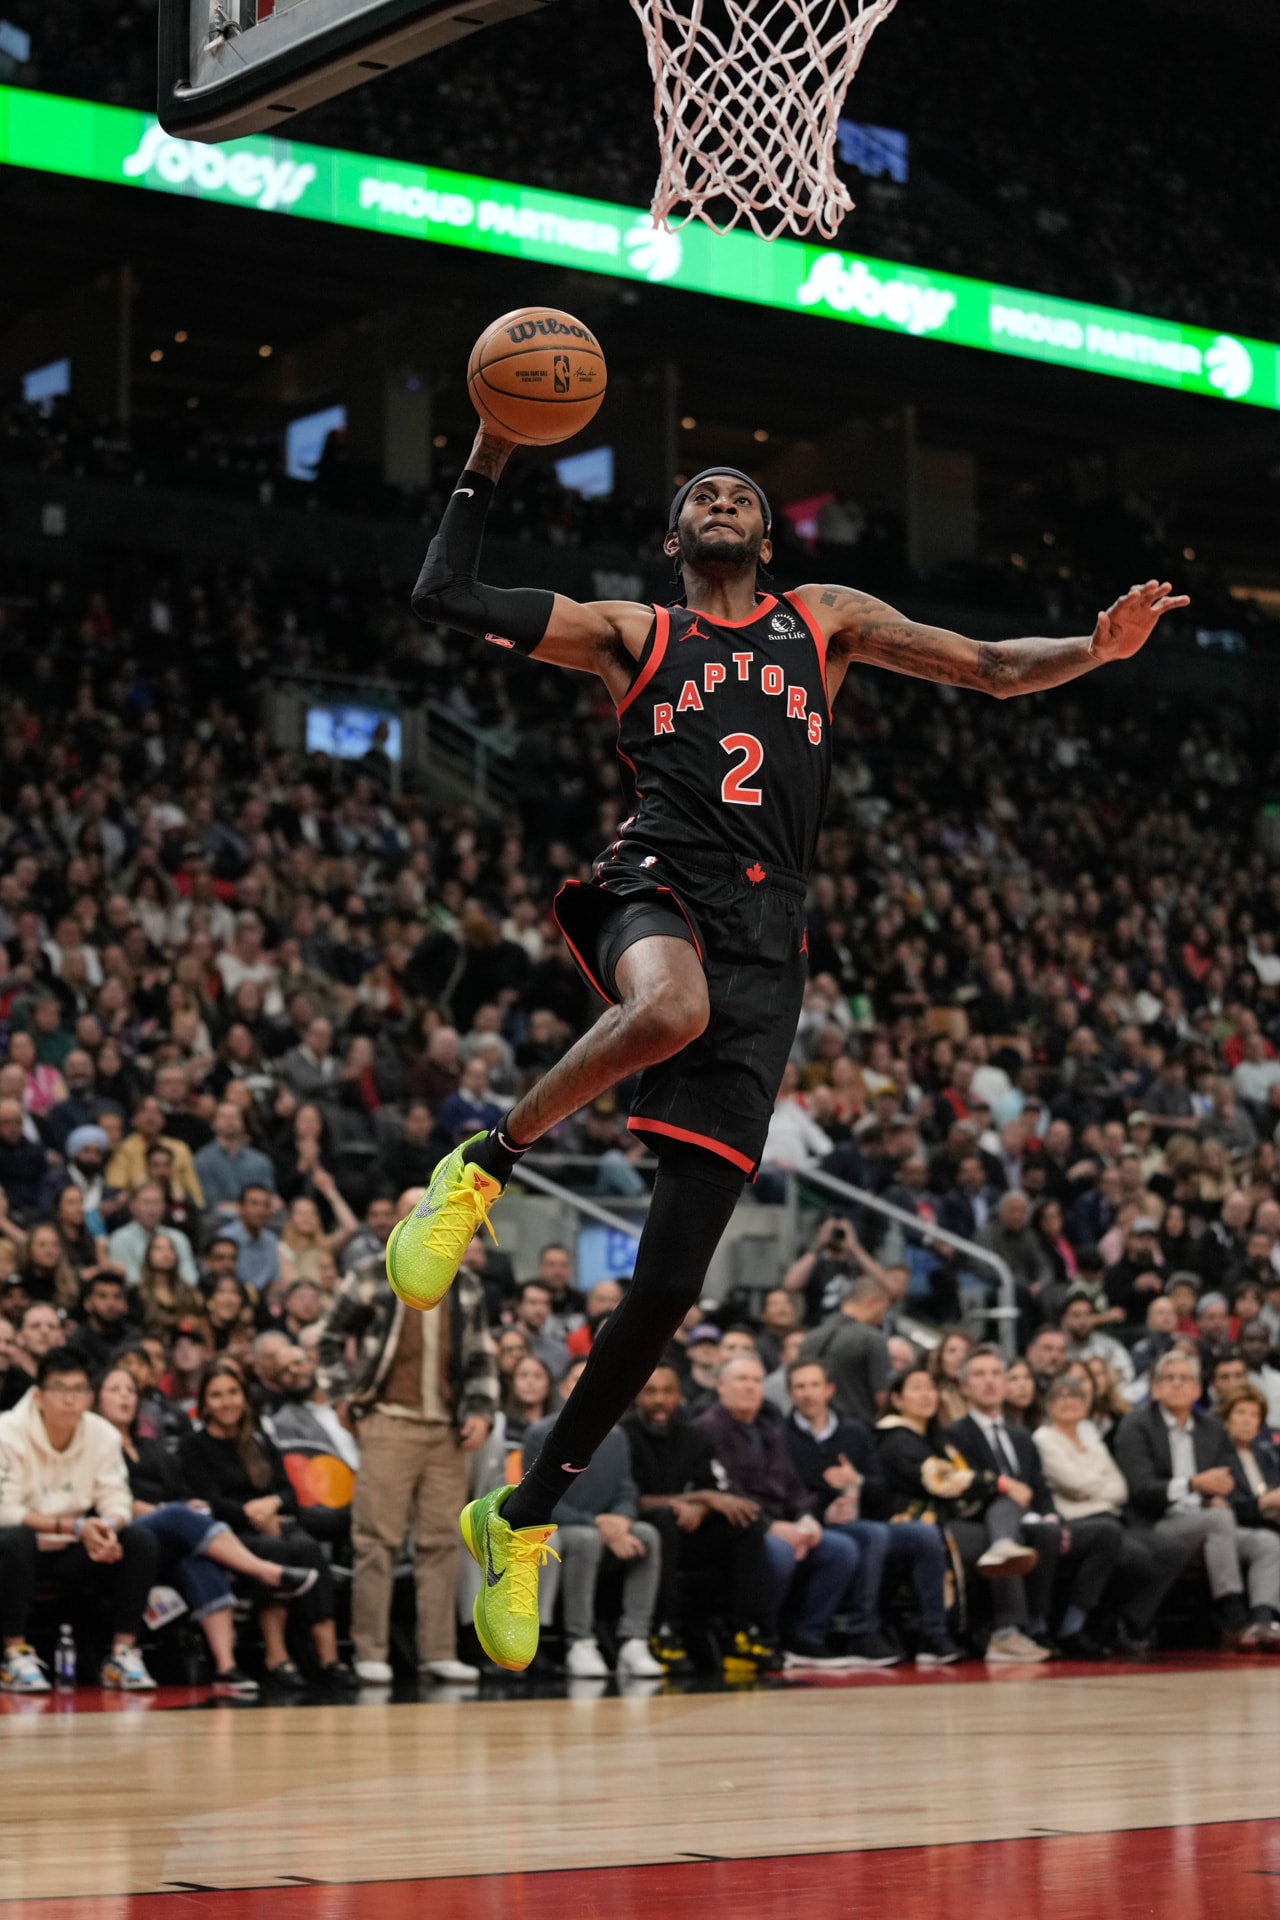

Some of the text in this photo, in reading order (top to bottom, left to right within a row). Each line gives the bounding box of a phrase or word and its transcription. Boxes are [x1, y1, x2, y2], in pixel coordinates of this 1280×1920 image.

[360, 178, 620, 256] PROUD PARTNER
[507, 318, 596, 346] Wilson
[989, 304, 1203, 376] PROUD PARTNER
[788, 631, 806, 640] Life
[654, 652, 822, 745] RAPTORS
[719, 732, 763, 806] 2
